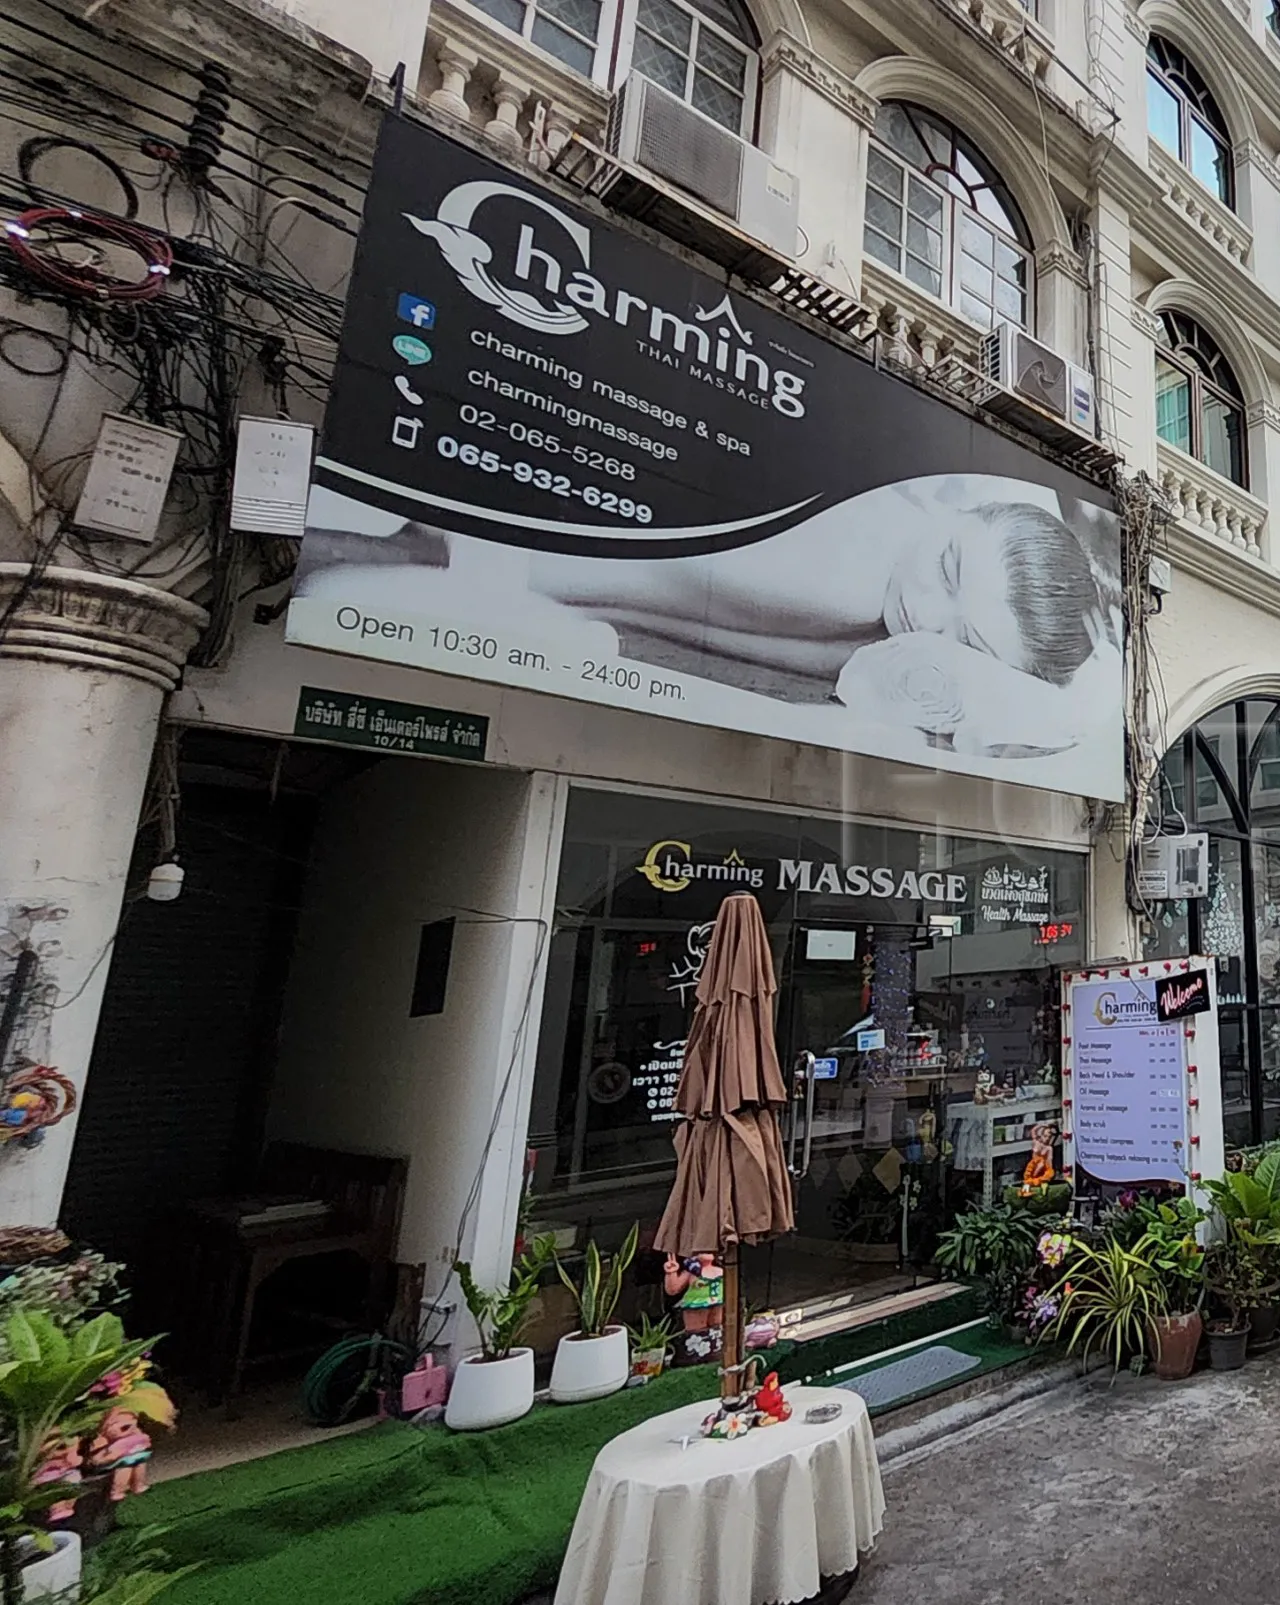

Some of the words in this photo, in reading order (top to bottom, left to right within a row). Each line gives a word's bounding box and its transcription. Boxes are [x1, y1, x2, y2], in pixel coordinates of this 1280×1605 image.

[401, 181, 806, 419] Charming
[470, 329, 583, 390] charming
[592, 378, 688, 430] massage
[694, 420, 709, 439] &
[715, 431, 752, 457] spa
[636, 339, 680, 369] THAI
[689, 367, 771, 410] MASSAGE
[458, 404, 637, 482] 02-065-5268
[468, 368, 679, 461] charmingmassage
[437, 435, 654, 524] 065-932-6299
[336, 605, 414, 643] Open
[430, 626, 498, 660] 10:30
[508, 648, 551, 672] am.
[581, 660, 641, 691] 24:00
[649, 678, 687, 701] pm.
[374, 735, 415, 750] 10/14
[635, 840, 764, 892] Charming
[776, 858, 968, 903] MASSAGE
[981, 905, 1011, 922] Health
[1012, 907, 1049, 926] Massage
[1093, 992, 1157, 1025] Charming
[1160, 977, 1203, 1016] Welcome
